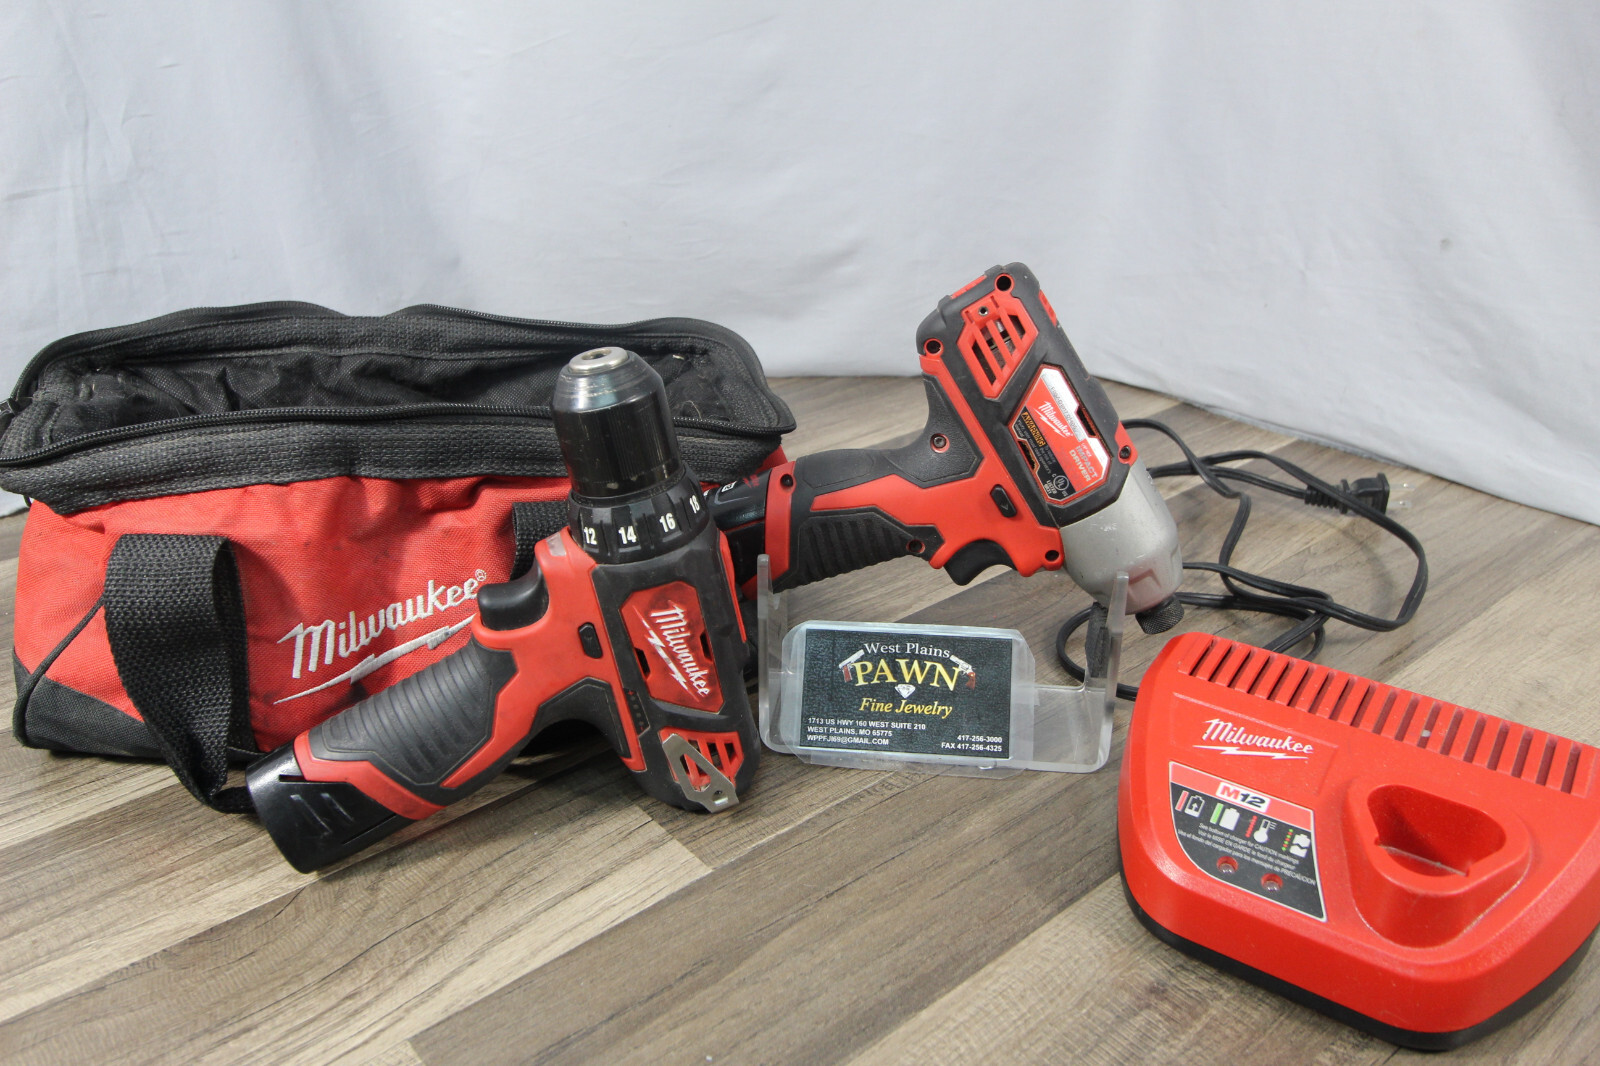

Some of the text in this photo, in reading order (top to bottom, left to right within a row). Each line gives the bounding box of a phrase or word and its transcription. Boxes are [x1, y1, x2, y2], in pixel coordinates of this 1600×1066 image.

[1038, 401, 1073, 437] Milwaukee
[1024, 417, 1046, 447] WARNING
[1068, 448, 1091, 482] DRIVER
[1075, 444, 1098, 478] IMPACT
[689, 494, 700, 514] 18
[660, 512, 676, 533] 16
[584, 526, 597, 545] 12
[618, 525, 637, 545] 14
[649, 600, 710, 697] Milwaukee
[863, 642, 951, 658] West Plains
[851, 658, 960, 691] PAWN
[859, 698, 953, 719] Fine Jewelry
[957, 735, 1002, 743] 417-256-3000
[1202, 718, 1314, 754] Milwaukee
[957, 743, 1002, 751] 417-256-4325
[1220, 785, 1266, 808] M12
[1253, 843, 1278, 856] CAUTION
